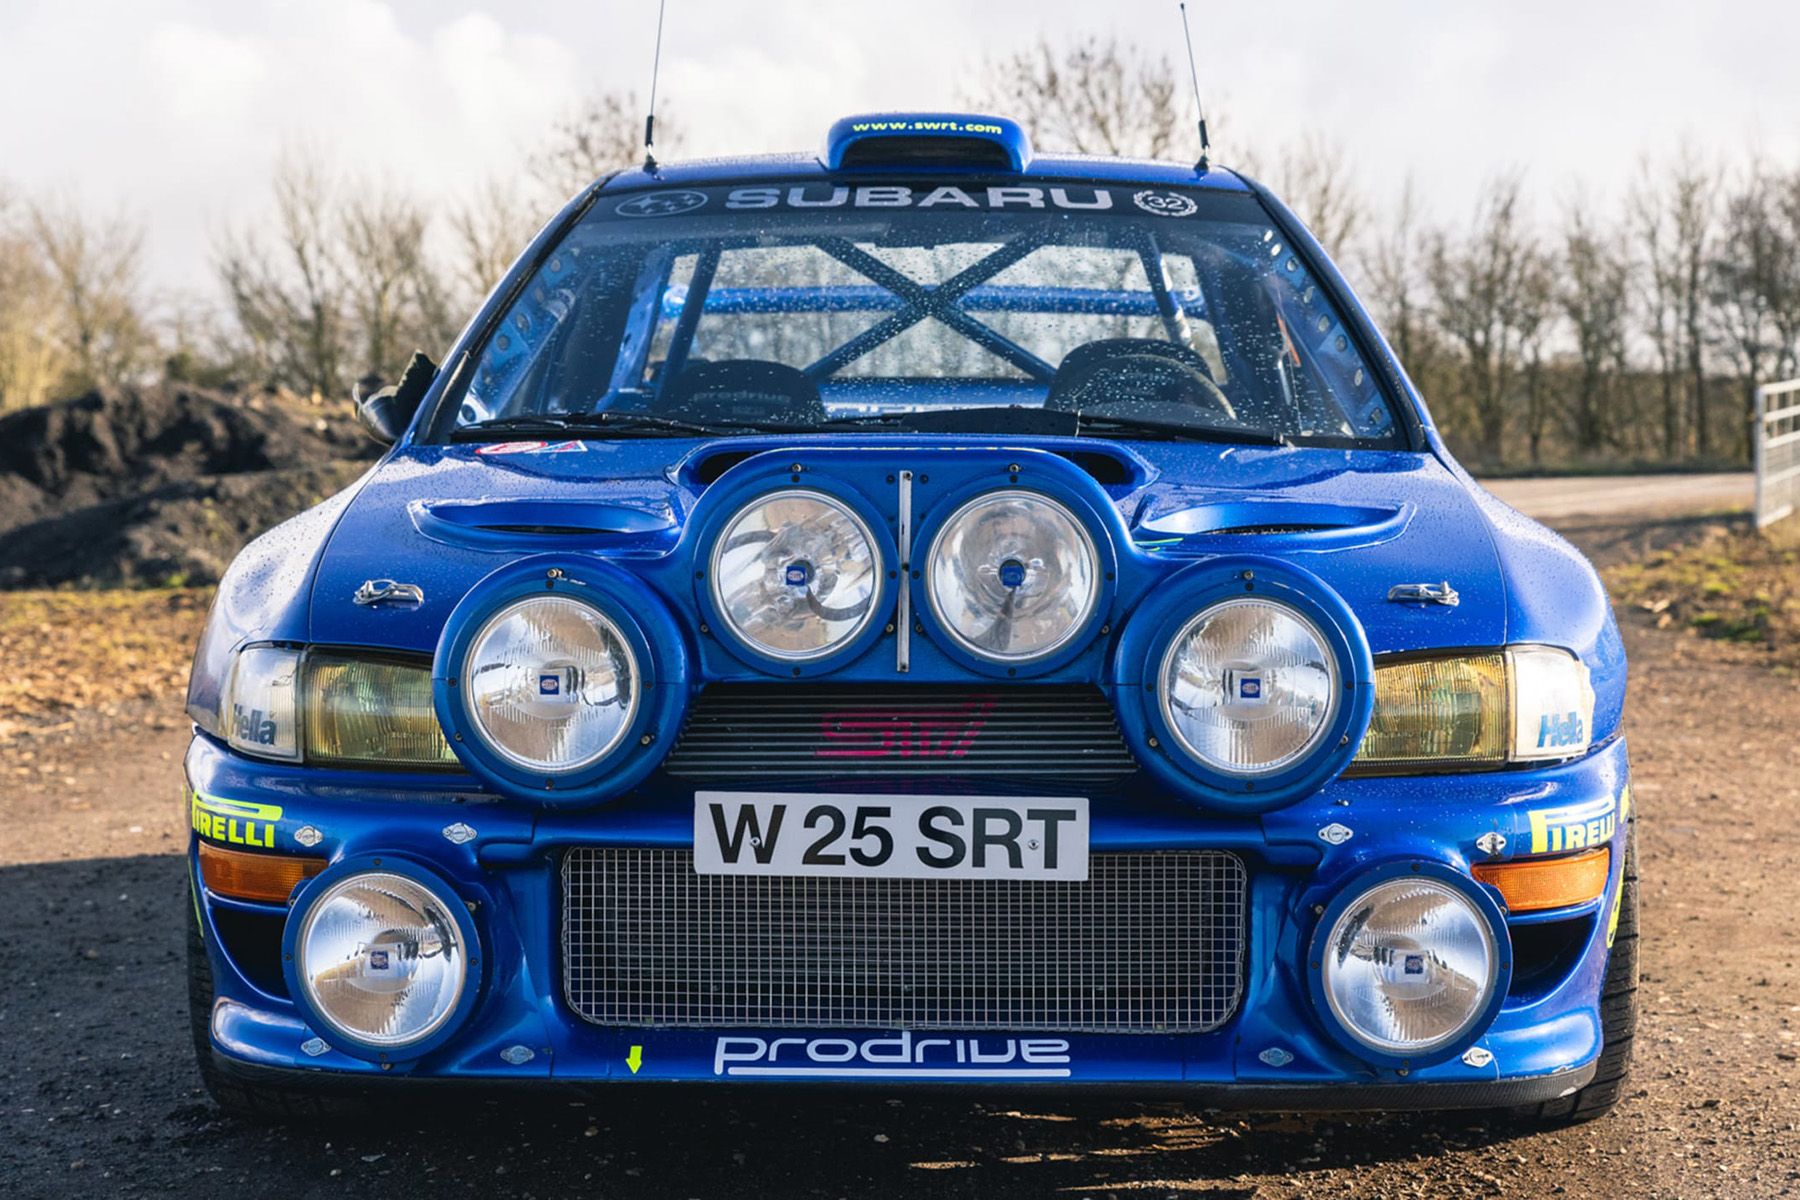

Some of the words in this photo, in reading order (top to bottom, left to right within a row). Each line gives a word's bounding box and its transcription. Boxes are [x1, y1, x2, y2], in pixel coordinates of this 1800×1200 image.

[852, 121, 1003, 135] www.swrt.com
[725, 187, 1113, 210] SUBARU
[1147, 196, 1184, 210] 32
[1536, 710, 1584, 748] Hella
[192, 790, 283, 848] PIRELLI
[709, 803, 786, 864] W
[802, 805, 894, 867] 25
[916, 806, 1077, 869] SRT
[714, 1031, 1071, 1076] prodrive
